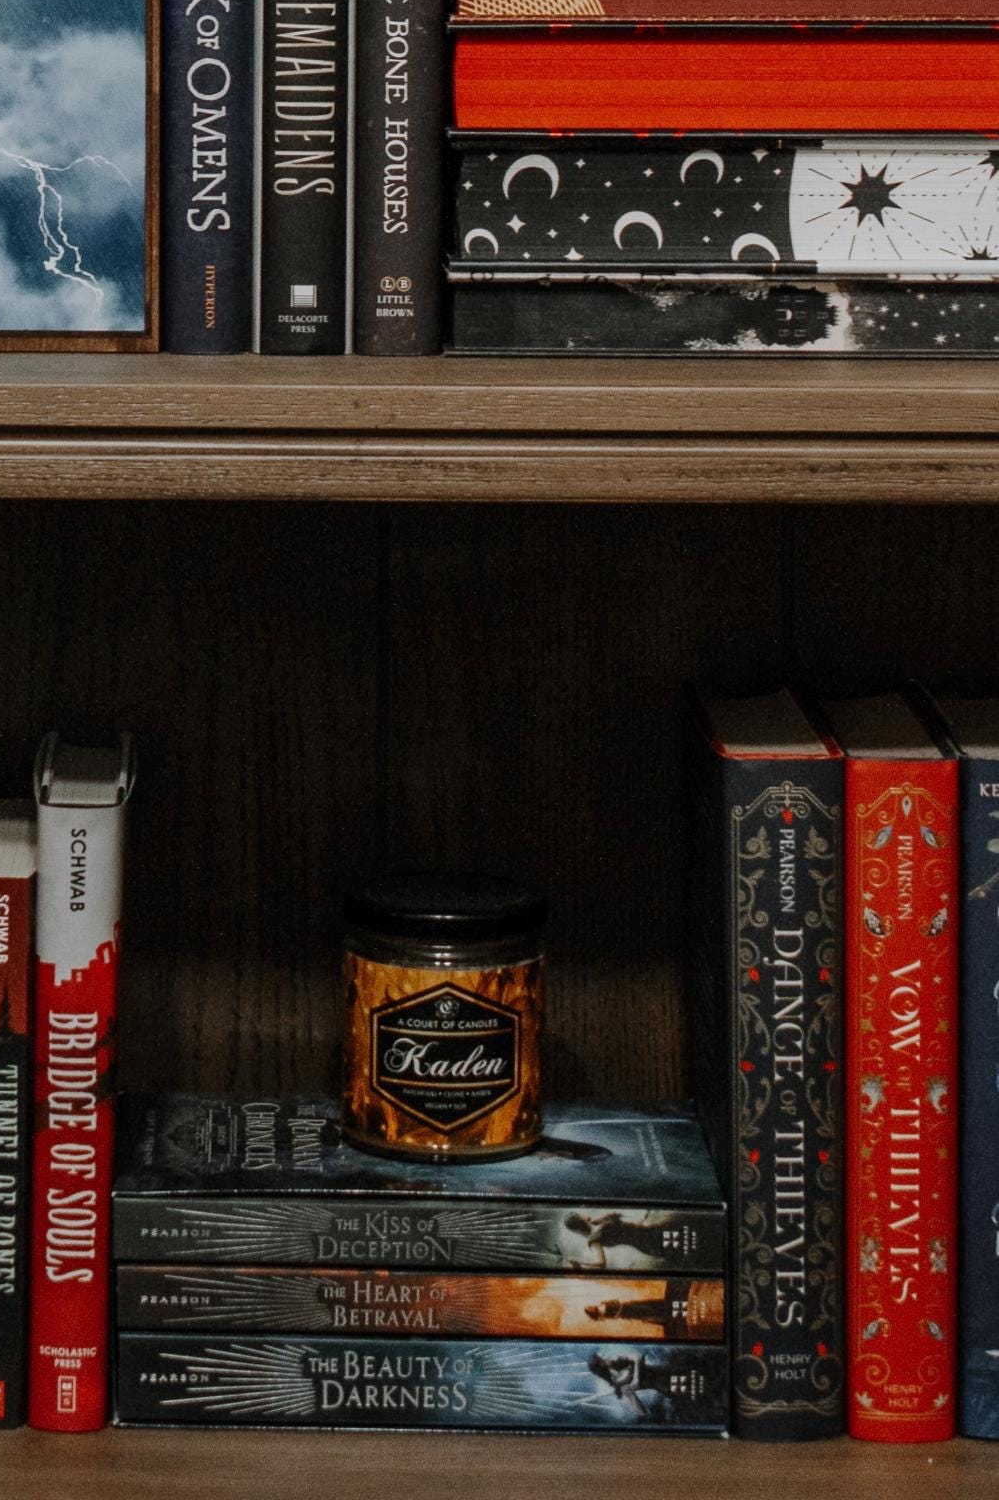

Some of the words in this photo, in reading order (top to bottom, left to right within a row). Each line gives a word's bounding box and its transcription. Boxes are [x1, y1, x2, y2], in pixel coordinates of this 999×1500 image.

[196, 14, 220, 50] OF
[385, 16, 410, 105] BONE
[186, 57, 231, 232] OMENS
[383, 116, 409, 235] HOUSES
[205, 263, 216, 330] HYPERION
[376, 307, 414, 317] BROWN
[278, 315, 329, 324] DELACORTE
[291, 325, 316, 333] PRESS
[70, 828, 87, 913] SCHWAB
[779, 828, 796, 914] PEARSON
[897, 834, 913, 922] PEARSON
[763, 927, 804, 1082] DANCE
[406, 1018, 438, 1029] COURT
[441, 1019, 455, 1029] OF
[457, 1018, 498, 1029] CANDLES
[47, 1010, 98, 1133] BRIDGE
[383, 1037, 506, 1078] Kaden
[50, 1142, 97, 1181] OF
[45, 1188, 98, 1285] SOULS
[140, 1228, 211, 1238] PEARSON
[774, 1119, 806, 1328] THIEVES
[140, 1294, 211, 1305] PEARSON
[322, 1285, 347, 1299] THE
[353, 1280, 425, 1302] HEART
[333, 1304, 441, 1328] BETRAYAL
[39, 1345, 97, 1358] SCHOLASTIC
[53, 1358, 83, 1369] PRESS
[308, 1357, 339, 1374] THE
[343, 1350, 450, 1380] BEAUTY
[769, 1354, 812, 1366] HENRY
[139, 1372, 210, 1383] PEARSON
[774, 1369, 807, 1381] HOLT
[883, 1384, 925, 1396] HENRY
[321, 1379, 468, 1412] DARKNESS
